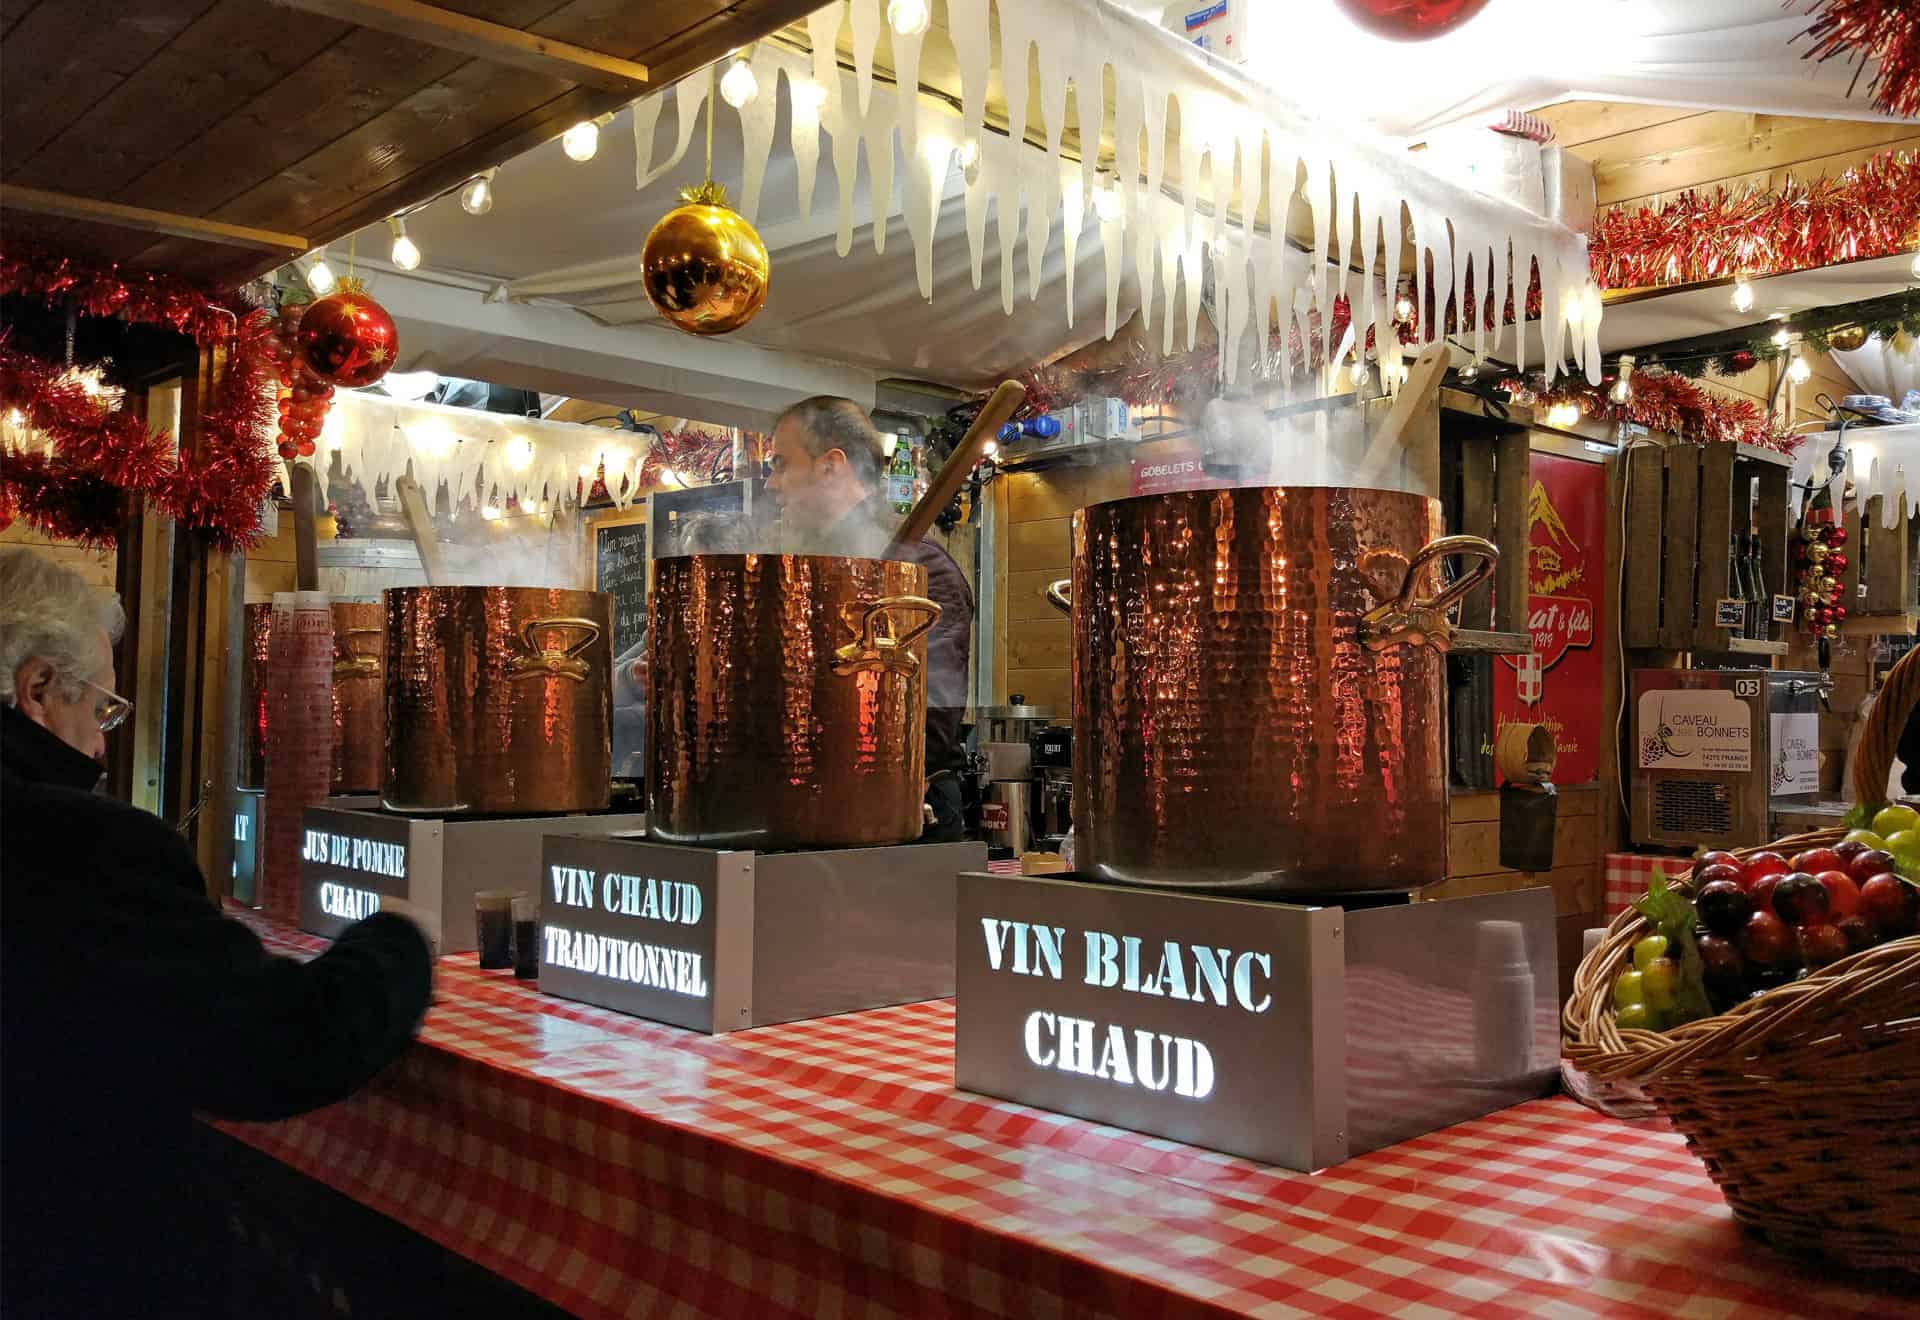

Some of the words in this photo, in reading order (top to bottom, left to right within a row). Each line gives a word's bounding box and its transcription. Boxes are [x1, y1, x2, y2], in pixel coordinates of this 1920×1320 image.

[1141, 462, 1194, 478] GOBELETS
[1534, 632, 1553, 648] 1919
[1737, 680, 1758, 695] 03
[1672, 714, 1718, 726] CAVEAU
[1697, 726, 1750, 738] BONNETS
[303, 830, 328, 863] JUS
[331, 835, 350, 868] DE
[352, 838, 405, 878] POMME
[551, 865, 595, 908] VIN
[603, 873, 702, 925] CHAUD
[544, 925, 707, 997] TRADITIONNEL
[981, 918, 1065, 979] VIN
[1083, 931, 1271, 1013] BLANC
[1024, 1011, 1215, 1098] CHAUD
